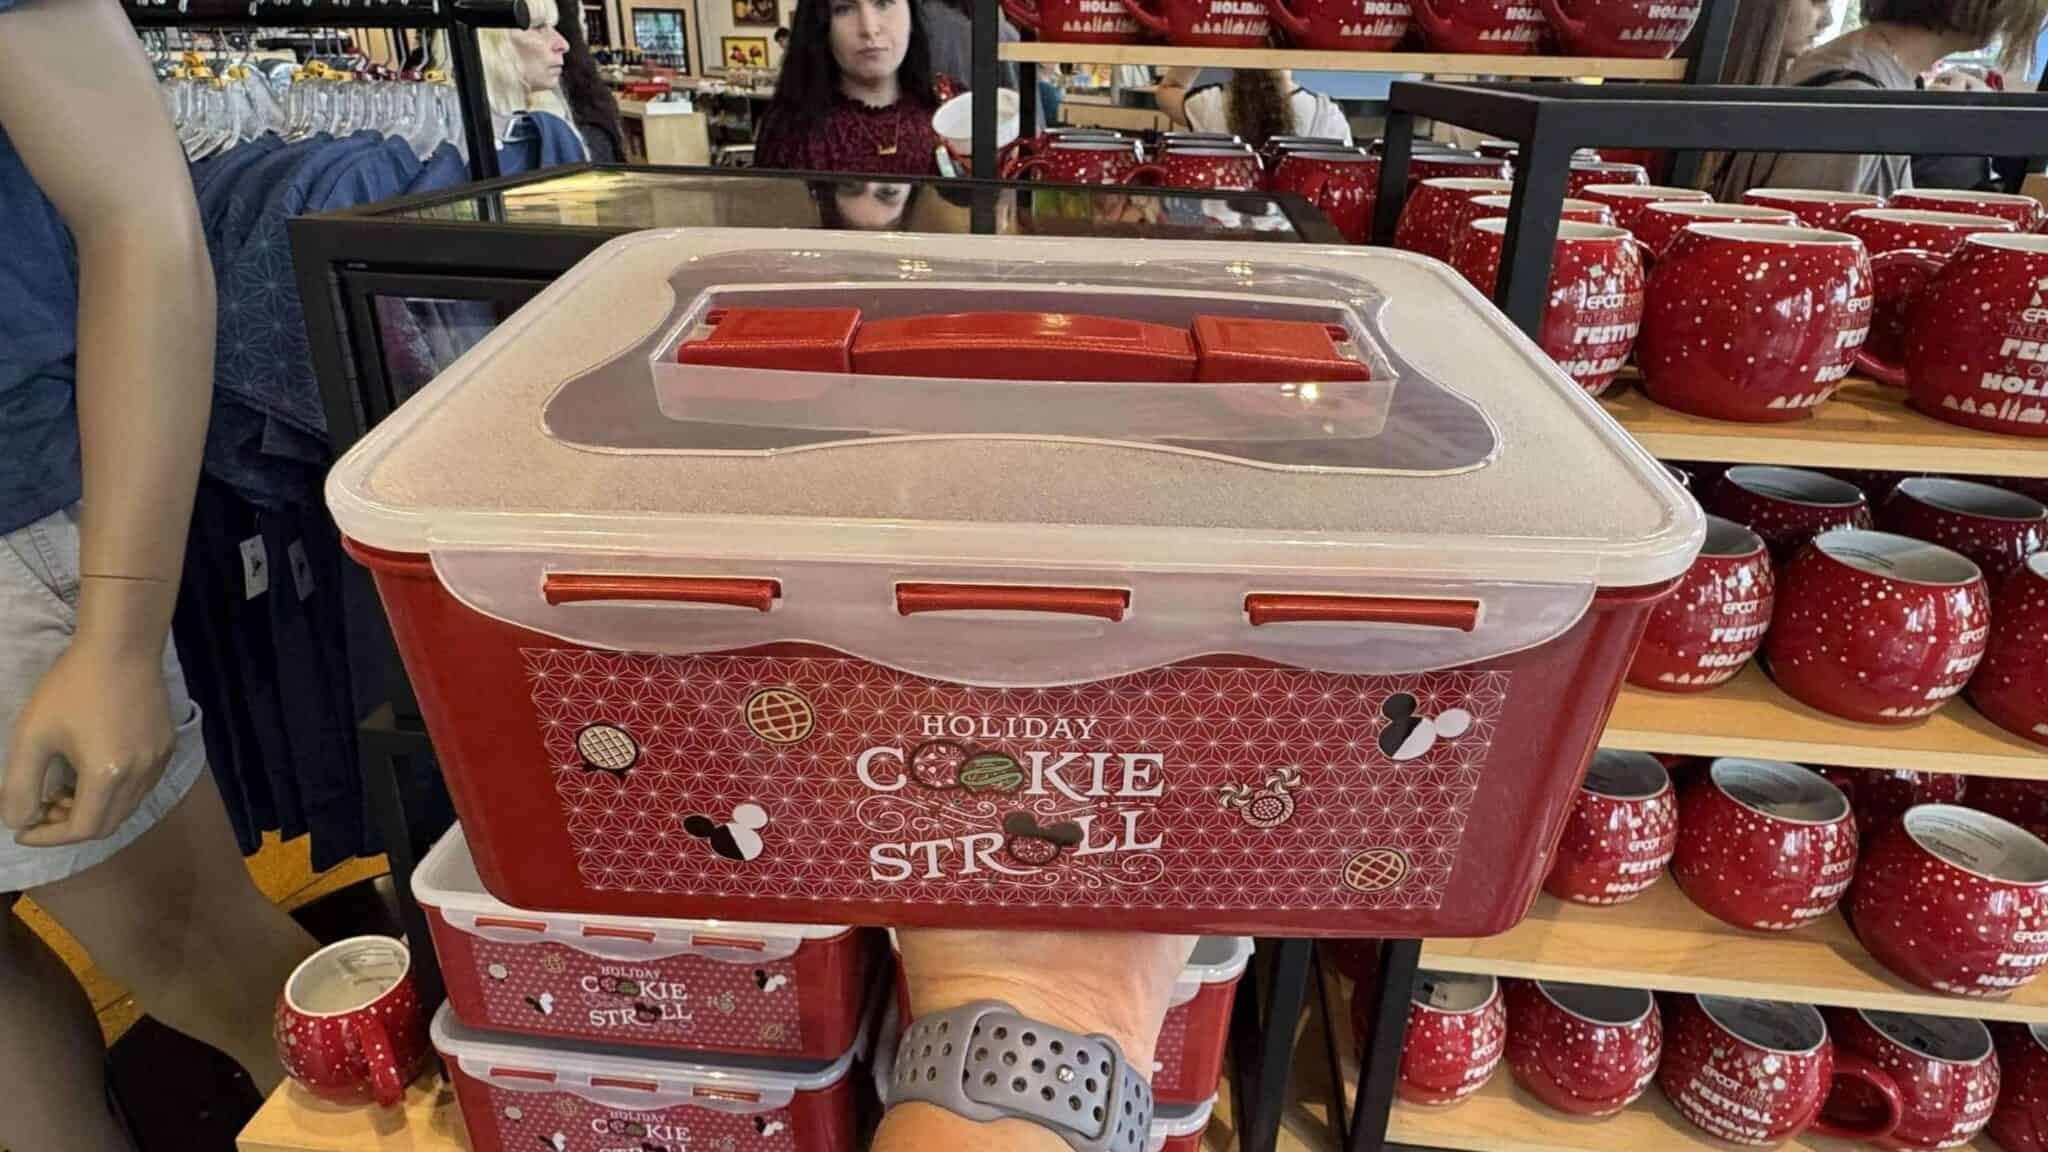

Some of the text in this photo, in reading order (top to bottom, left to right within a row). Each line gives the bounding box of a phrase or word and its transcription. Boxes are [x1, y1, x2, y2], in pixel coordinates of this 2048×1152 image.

[1587, 293, 1626, 309] EPCOT
[1722, 599, 1760, 615] EPCOT
[922, 714, 1099, 740] HOLIDAY
[856, 746, 1165, 801] COOKIE
[869, 810, 1164, 881] STROLL
[601, 966, 661, 979] HOLIDAY
[581, 975, 689, 1001] COOKIE
[589, 1003, 695, 1026] STROLL
[1701, 1063, 1742, 1091] EPCOT
[1680, 1090, 1769, 1138] HOLIDAYS
[1690, 1077, 1774, 1125] FESTIVAL
